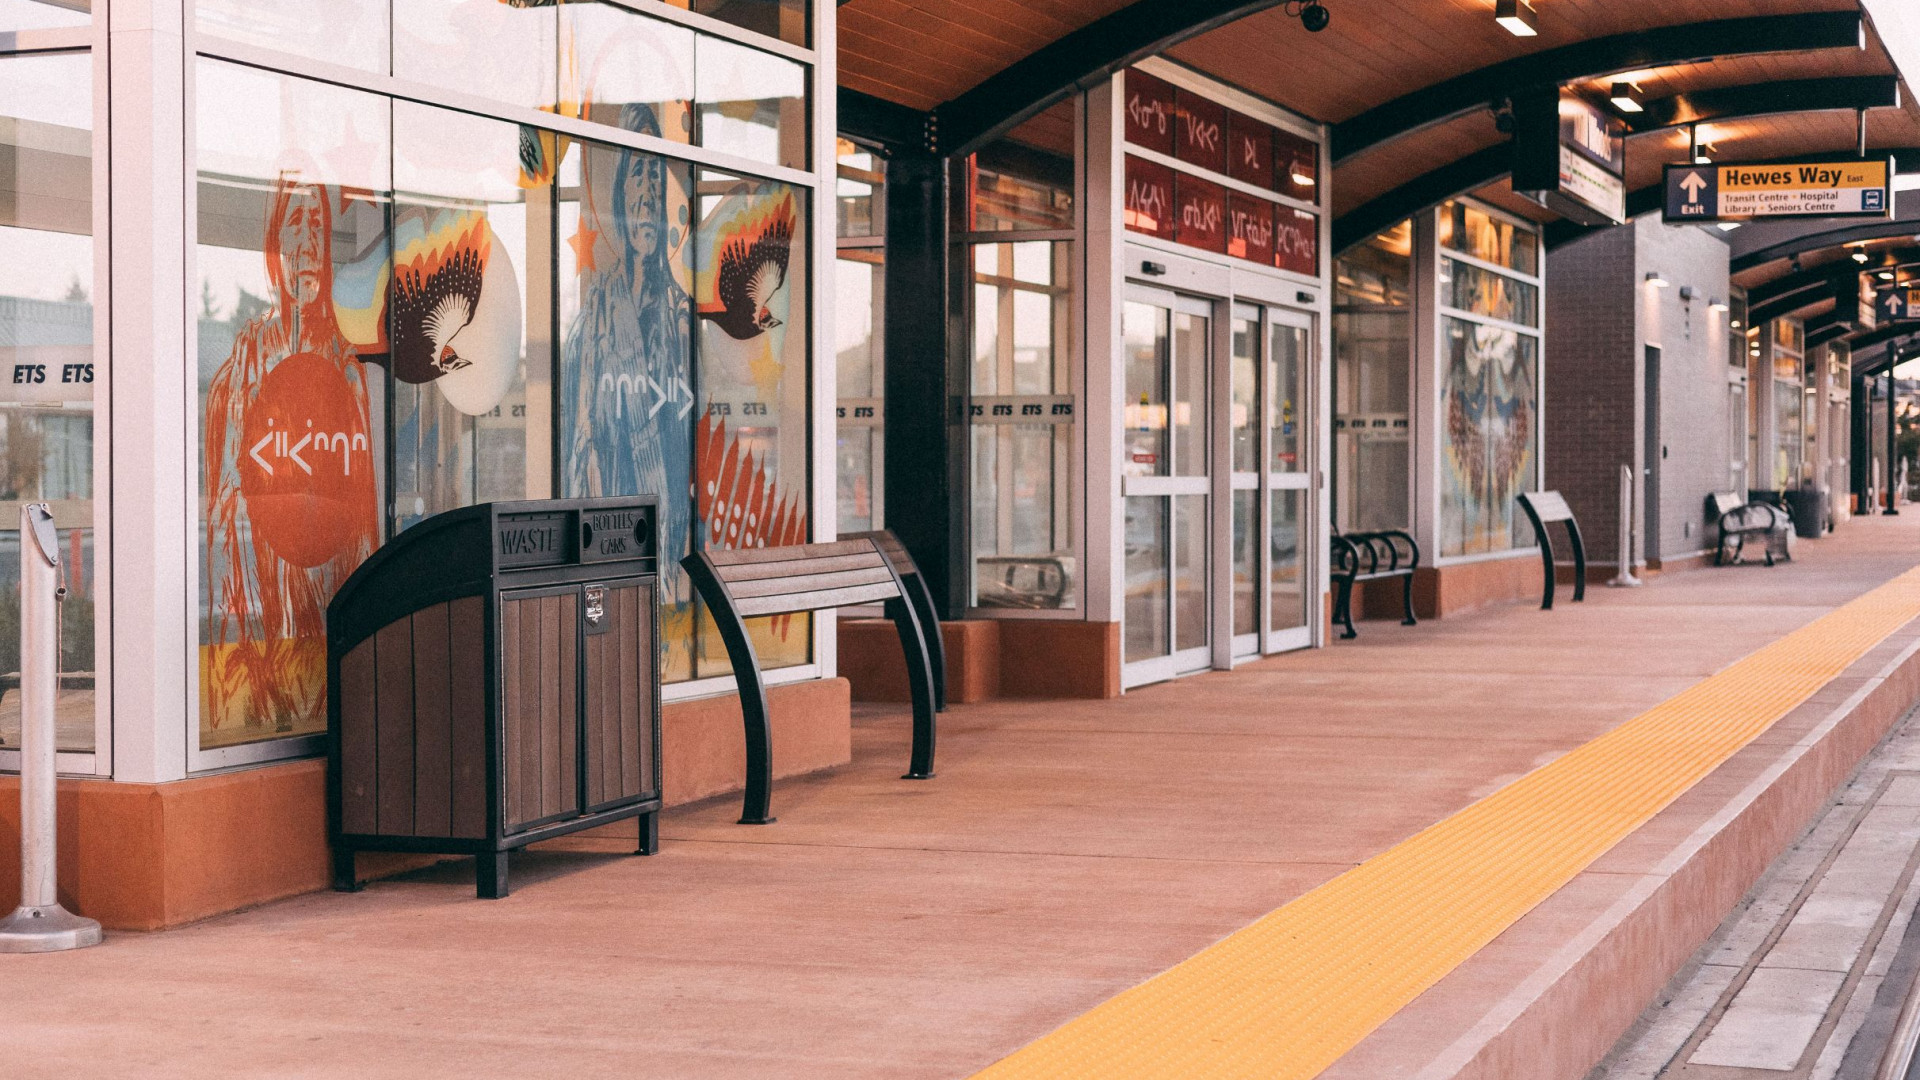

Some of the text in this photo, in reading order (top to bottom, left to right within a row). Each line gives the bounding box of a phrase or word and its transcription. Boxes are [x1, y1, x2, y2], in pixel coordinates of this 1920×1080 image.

[1726, 167, 1864, 187] Hewes Way East
[1725, 191, 1839, 203] Transit Centre Hospital
[1681, 204, 1704, 215] Exit
[1724, 202, 1836, 215] Library Seniors Centre
[13, 363, 94, 384] ETS ETS
[855, 406, 874, 418] ETS
[992, 404, 1013, 416] ETS
[1022, 404, 1042, 415] ETS
[1052, 404, 1072, 415] ETS
[592, 512, 635, 531] BOTTLES
[502, 527, 558, 555] WASTE
[600, 537, 627, 555] CANS
